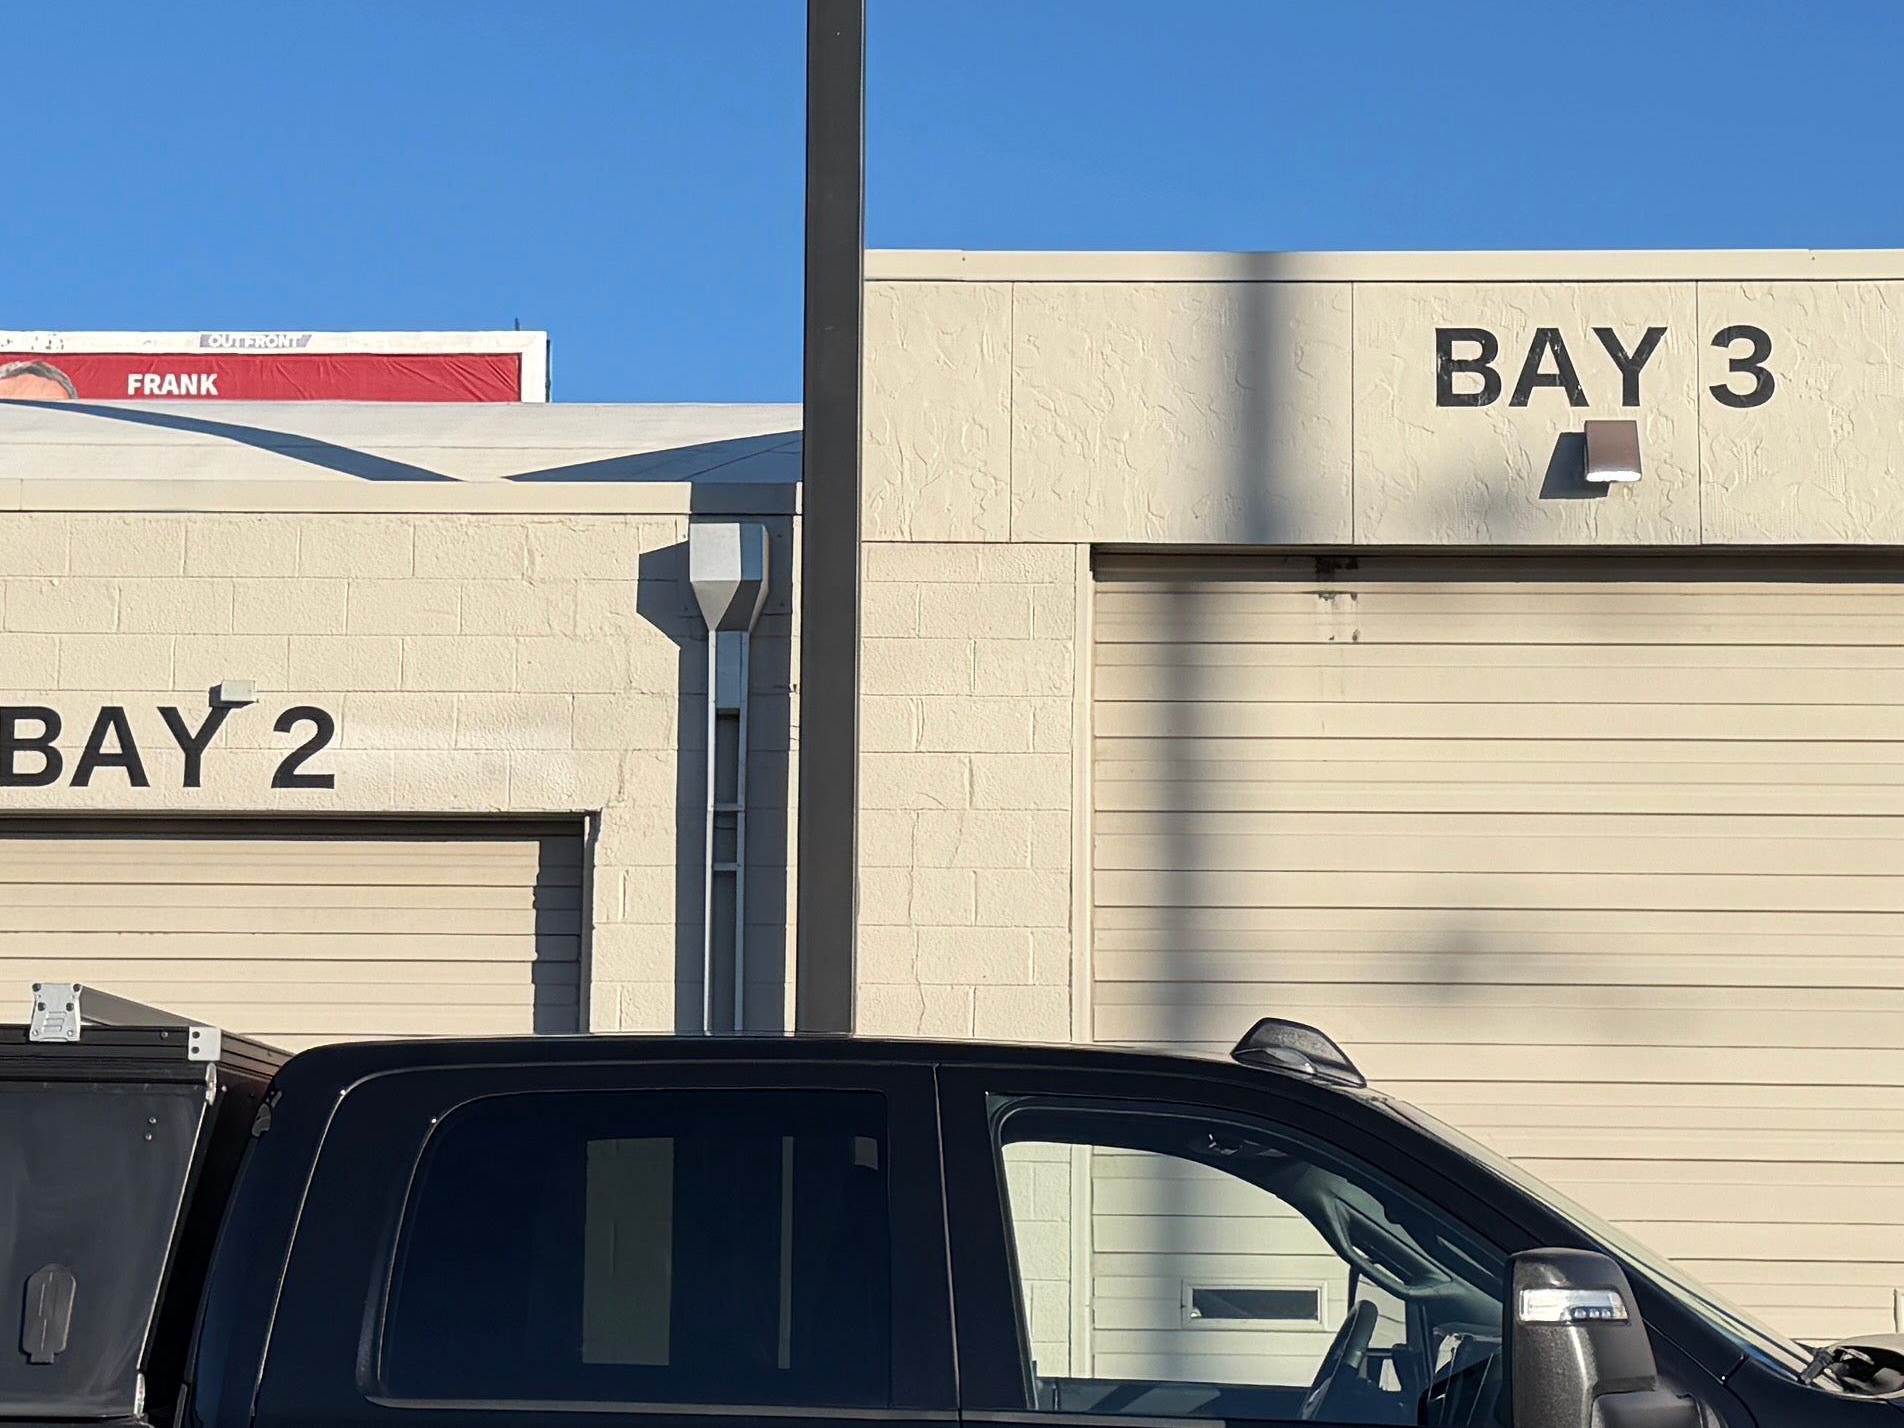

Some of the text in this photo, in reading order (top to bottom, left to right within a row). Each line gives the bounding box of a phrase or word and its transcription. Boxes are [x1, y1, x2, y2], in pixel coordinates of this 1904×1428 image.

[208, 334, 302, 348] OUTFRONT
[1436, 325, 1775, 409] BAY 3
[127, 373, 219, 396] FRANK
[270, 705, 336, 790] 2
